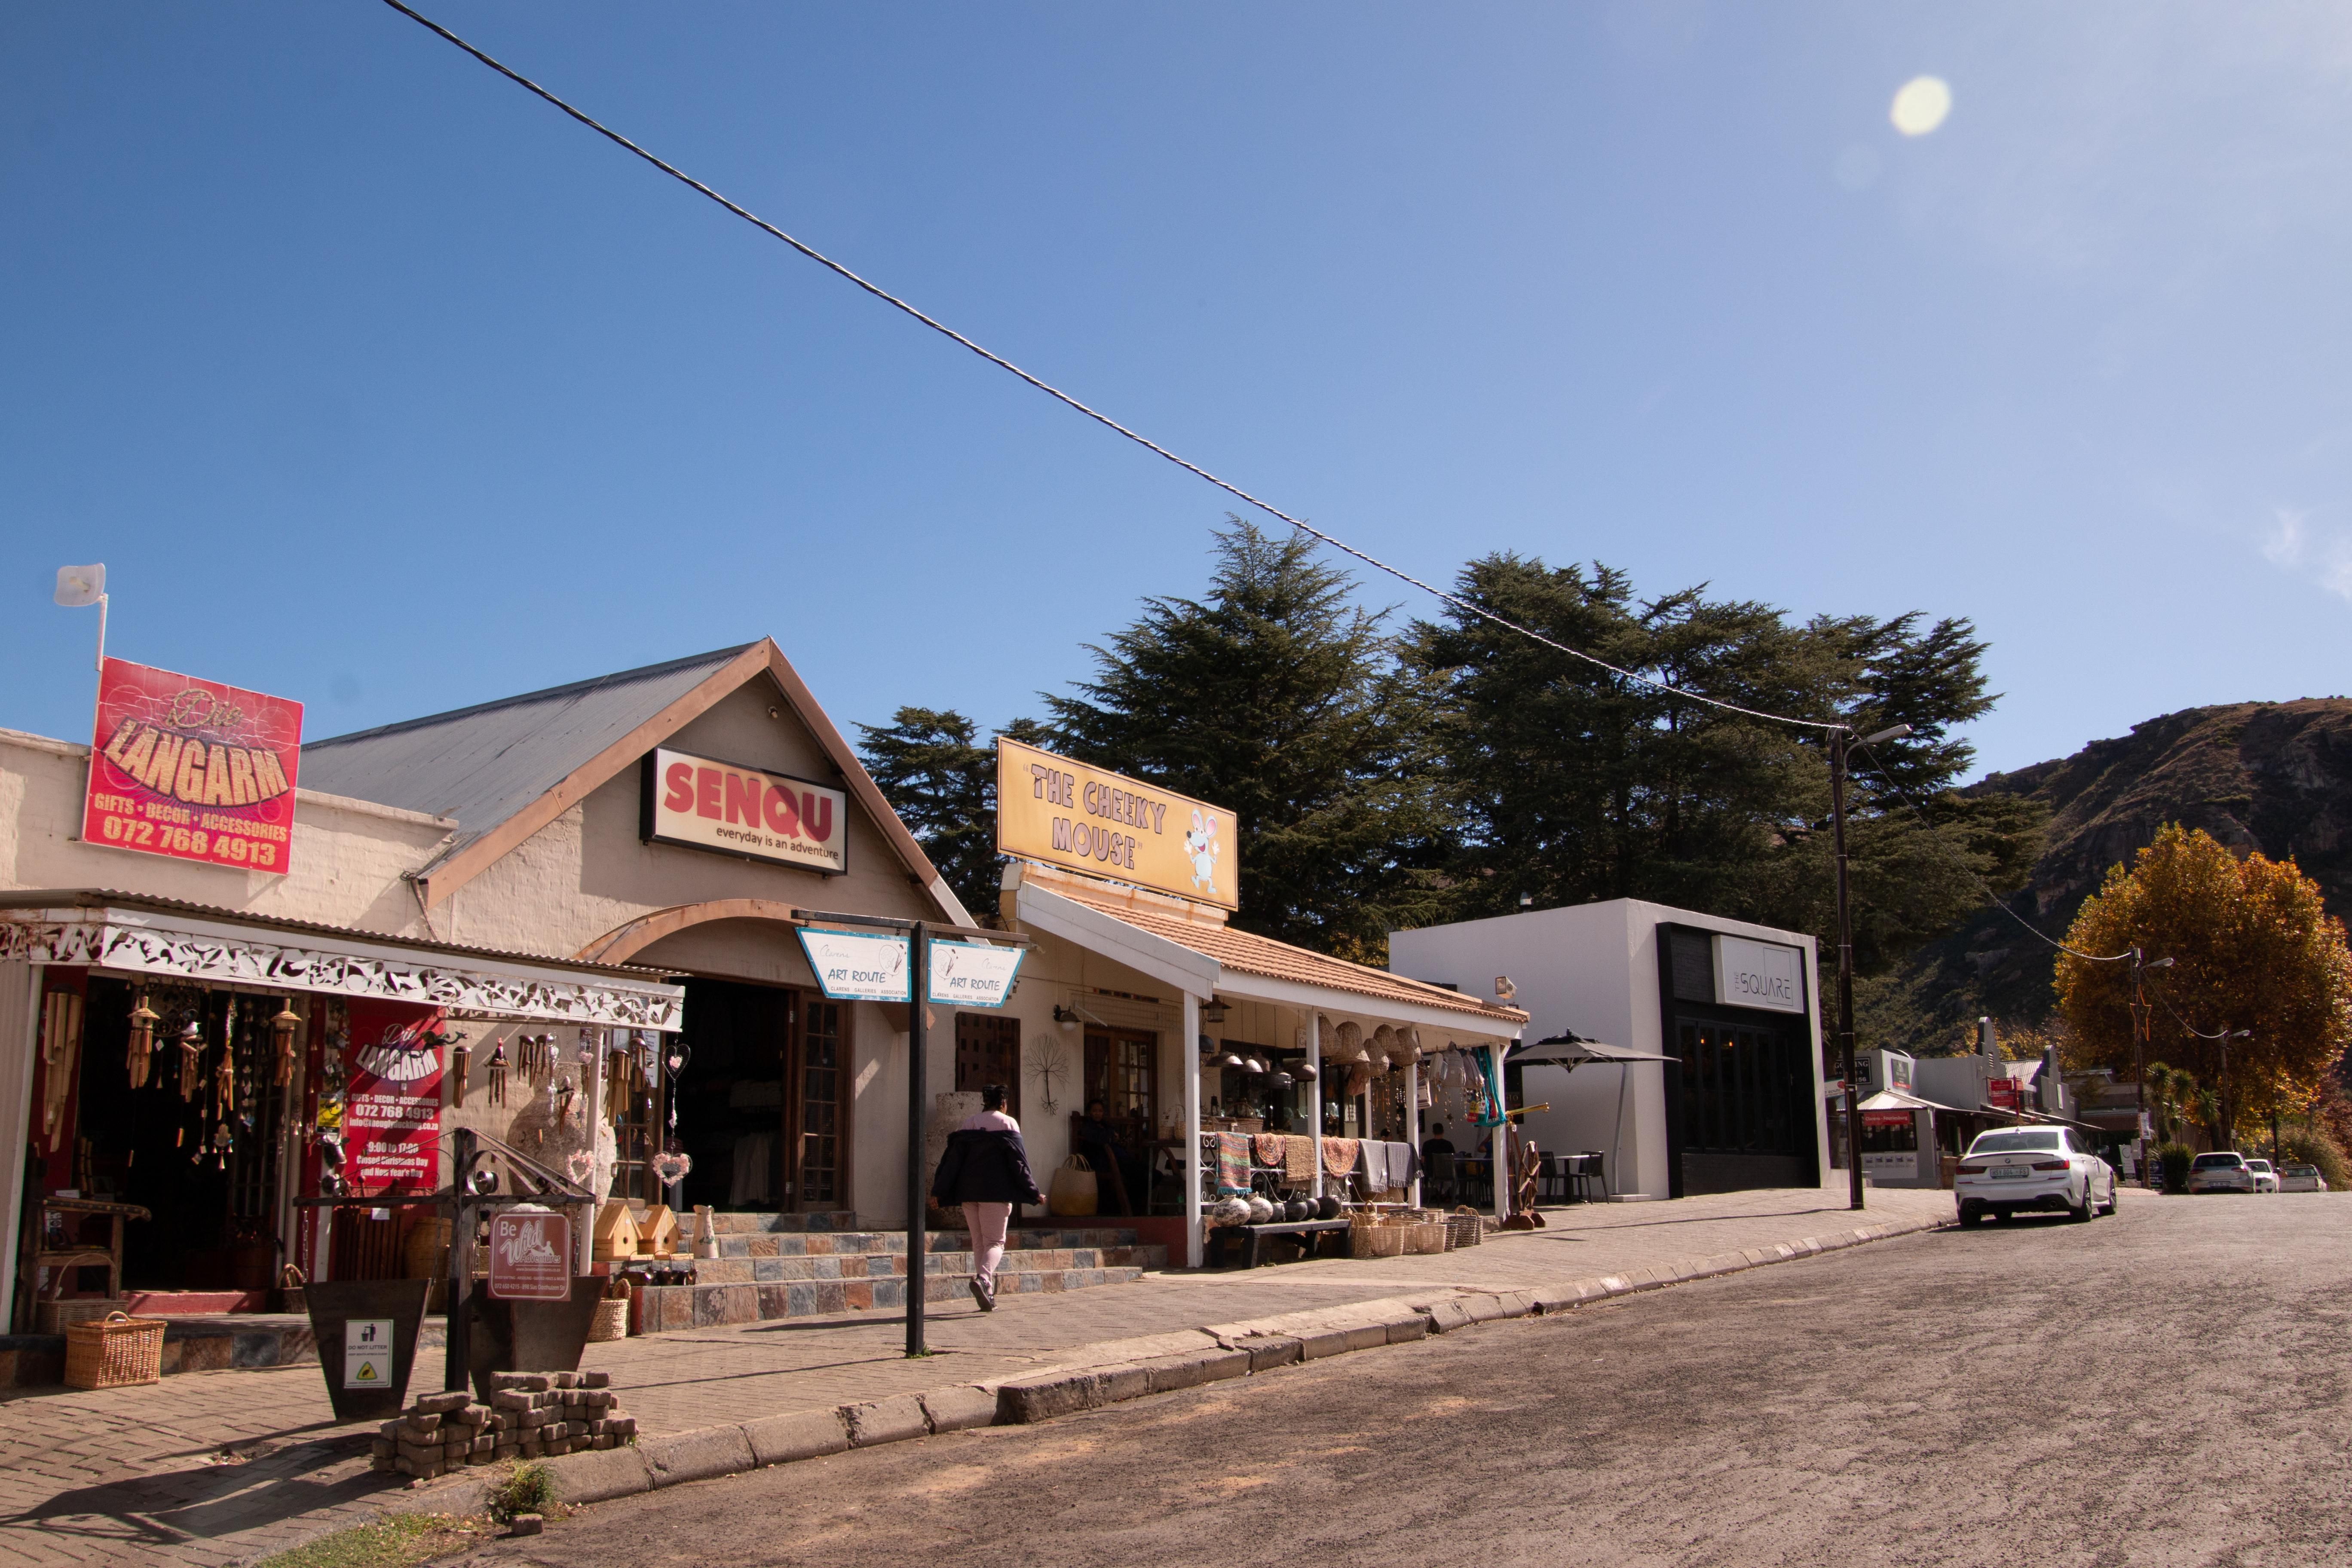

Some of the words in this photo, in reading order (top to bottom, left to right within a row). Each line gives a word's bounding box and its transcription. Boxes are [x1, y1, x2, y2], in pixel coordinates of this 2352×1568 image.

[165, 689, 243, 729] Die
[101, 717, 289, 808] LANGARM
[664, 763, 832, 842] SENQU
[1084, 781, 1166, 835] CHEEKY
[94, 793, 135, 814] GIFTS
[146, 802, 190, 824] DECOR
[201, 813, 286, 842] ACCESSORIES
[103, 816, 155, 845] 072
[159, 826, 208, 855] 768
[213, 836, 276, 866] 4913
[717, 827, 763, 847] everyday
[765, 835, 773, 846] is
[775, 839, 787, 848] an
[790, 841, 839, 860] adventure
[820, 944, 850, 958] Clarens
[828, 968, 848, 981] ART
[852, 970, 886, 983] ROUTE
[950, 977, 967, 988] ART
[971, 979, 1000, 991] ROUTE
[1740, 973, 1791, 999] SQUARE
[382, 1023, 416, 1045] Die
[355, 1044, 439, 1081] LANGARM
[352, 1093, 370, 1102] GIFTS
[374, 1095, 395, 1104] DECOR
[399, 1096, 438, 1106] ACCESSORIES
[355, 1104, 378, 1116] 072
[380, 1106, 403, 1118] 768
[405, 1108, 433, 1119] 4913
[388, 1143, 396, 1152] to
[398, 1143, 419, 1154] 17:00
[357, 1155, 380, 1165] Closed
[381, 1156, 414, 1166] Christmas
[416, 1158, 428, 1167] Day
[361, 1168, 374, 1176] and
[375, 1168, 388, 1176] New
[411, 1170, 423, 1178] Day
[500, 1221, 516, 1237] Be
[500, 1220, 542, 1266] Wild
[521, 1254, 561, 1263] Adventures
